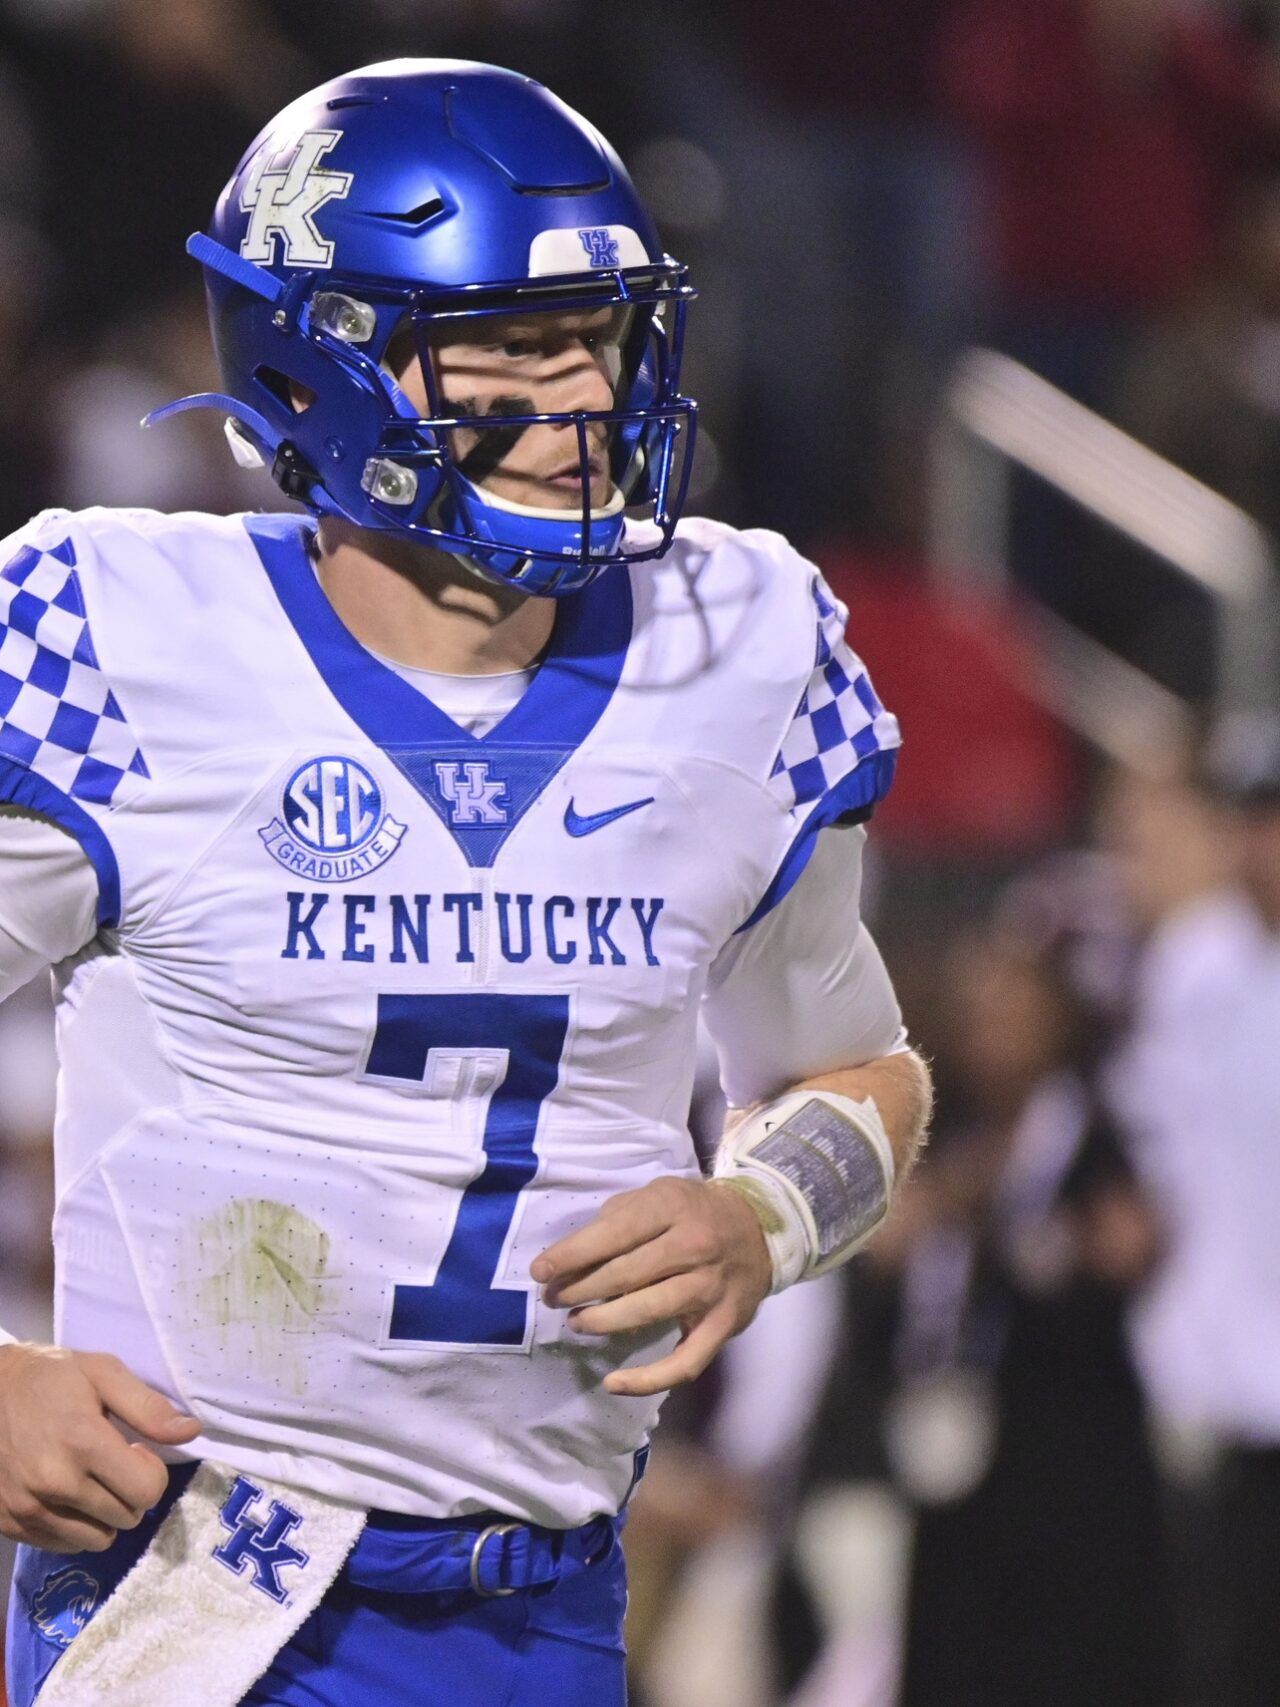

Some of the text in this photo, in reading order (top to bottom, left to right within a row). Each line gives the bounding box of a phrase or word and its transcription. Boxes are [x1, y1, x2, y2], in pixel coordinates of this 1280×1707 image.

[239, 129, 354, 269] UK
[578, 229, 619, 268] UK
[288, 760, 376, 848] SEC
[434, 762, 510, 825] UK
[277, 840, 389, 878] GRADUATE
[281, 891, 664, 967] KENTUCKY
[361, 988, 575, 1350] 7
[211, 1475, 310, 1604] UK
